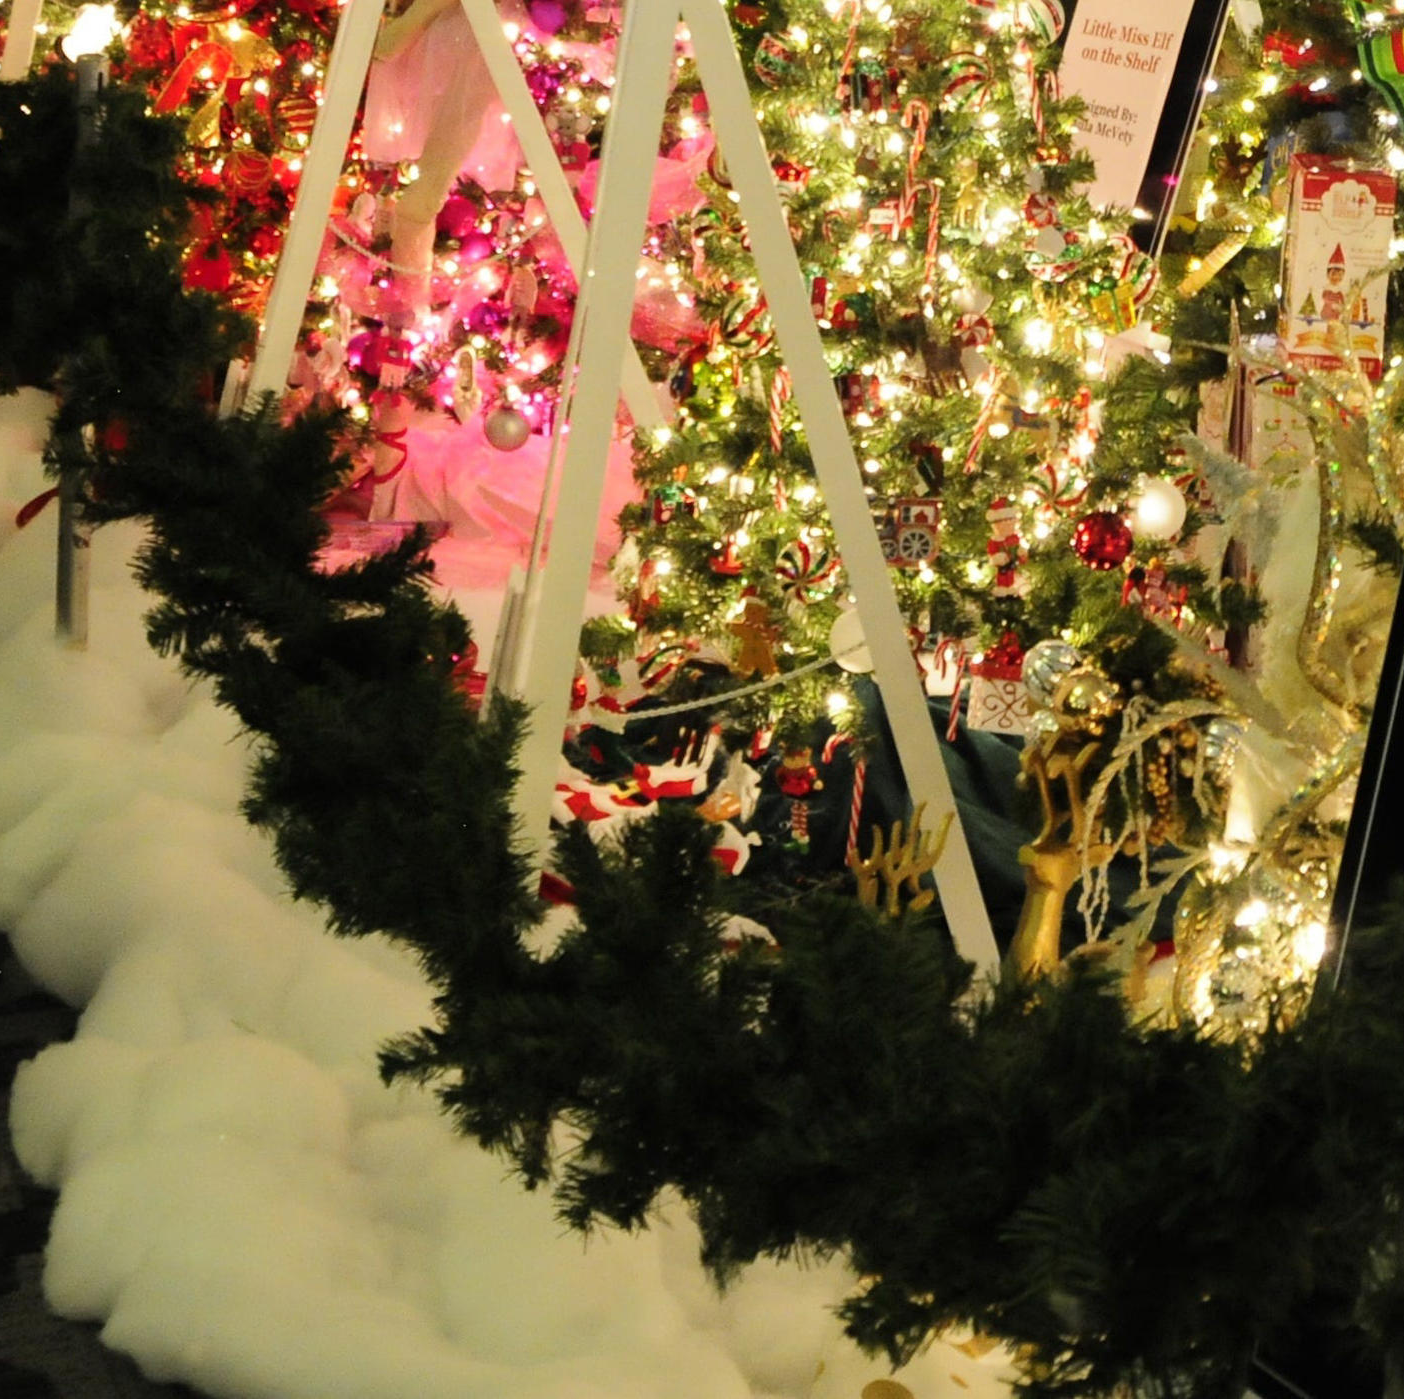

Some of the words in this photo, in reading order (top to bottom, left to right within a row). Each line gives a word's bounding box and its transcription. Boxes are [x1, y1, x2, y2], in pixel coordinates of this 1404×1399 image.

[1082, 18, 1117, 41] Little
[1119, 26, 1149, 46] Miss
[1152, 31, 1174, 51] Elf
[1081, 46, 1098, 61] on
[1100, 47, 1122, 66] the
[1123, 51, 1162, 74] Shelf
[1086, 100, 1120, 119] signed
[1121, 107, 1138, 126] By:
